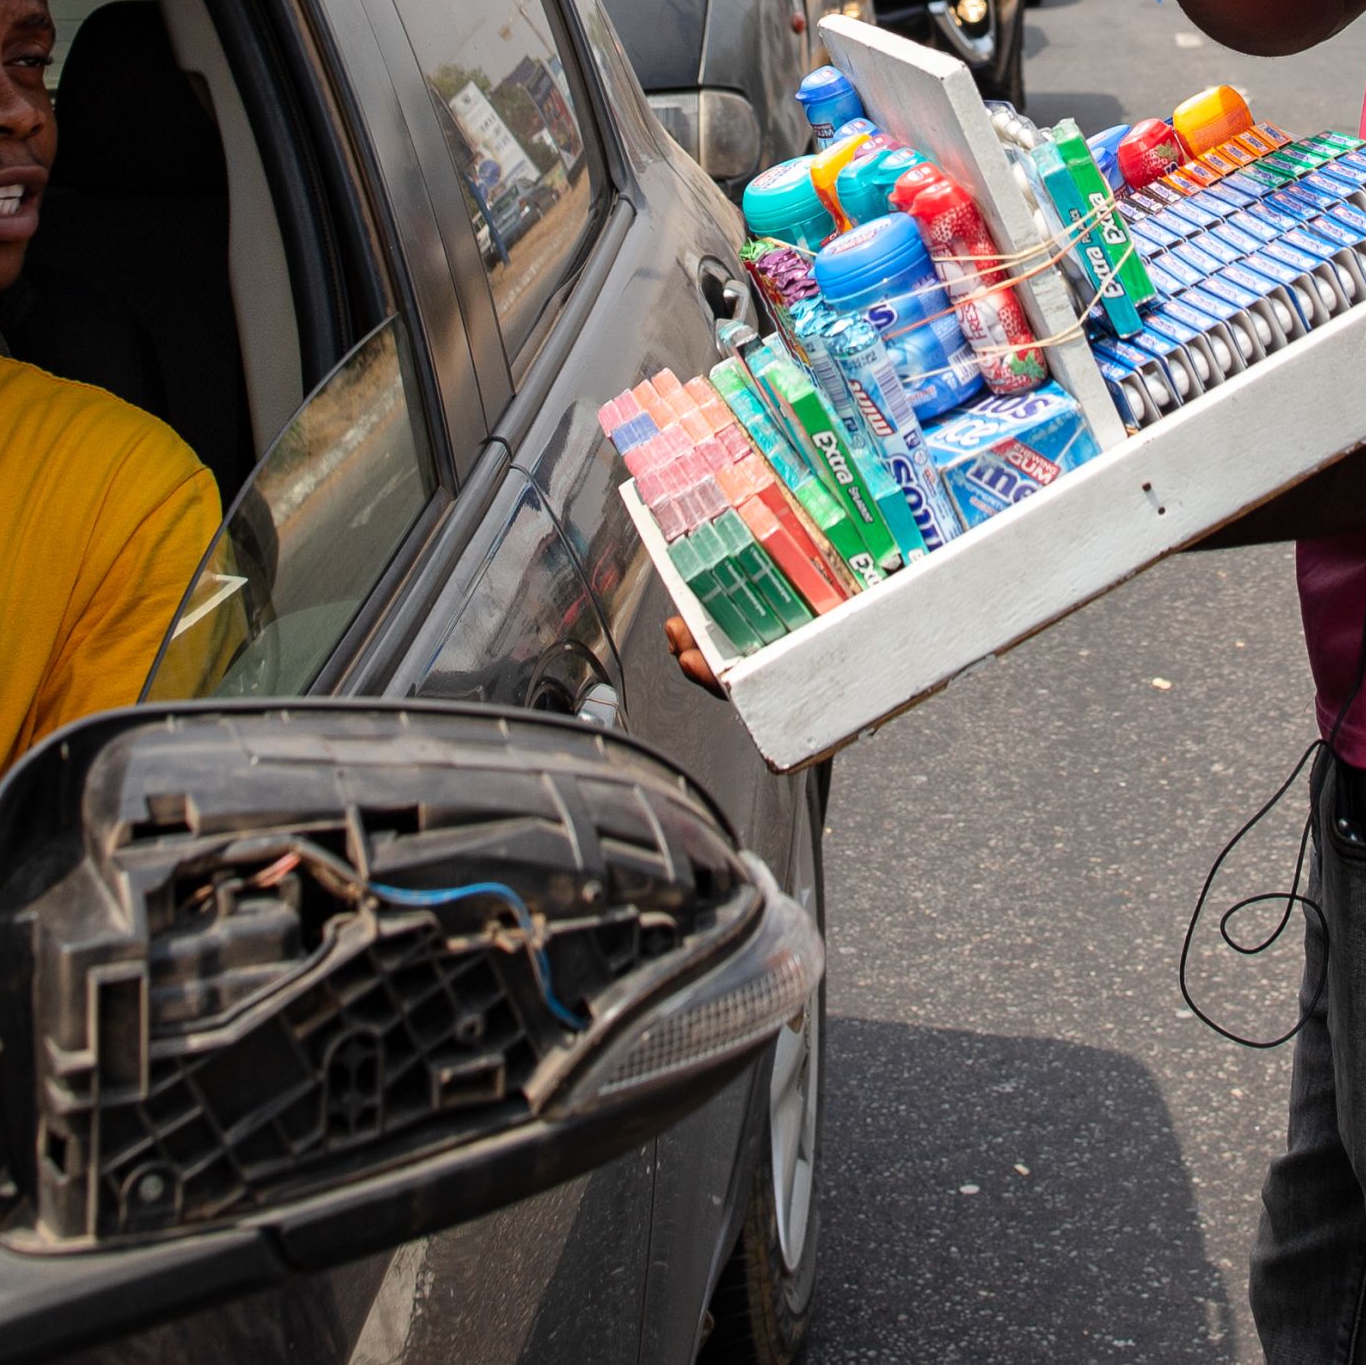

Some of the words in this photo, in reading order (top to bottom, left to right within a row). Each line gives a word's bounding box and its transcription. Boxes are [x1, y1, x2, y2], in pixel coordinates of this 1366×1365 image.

[1088, 192, 1126, 246] Extra
[1085, 246, 1125, 299] Extra
[812, 430, 854, 486] Extra
[1006, 450, 1054, 486] GUM
